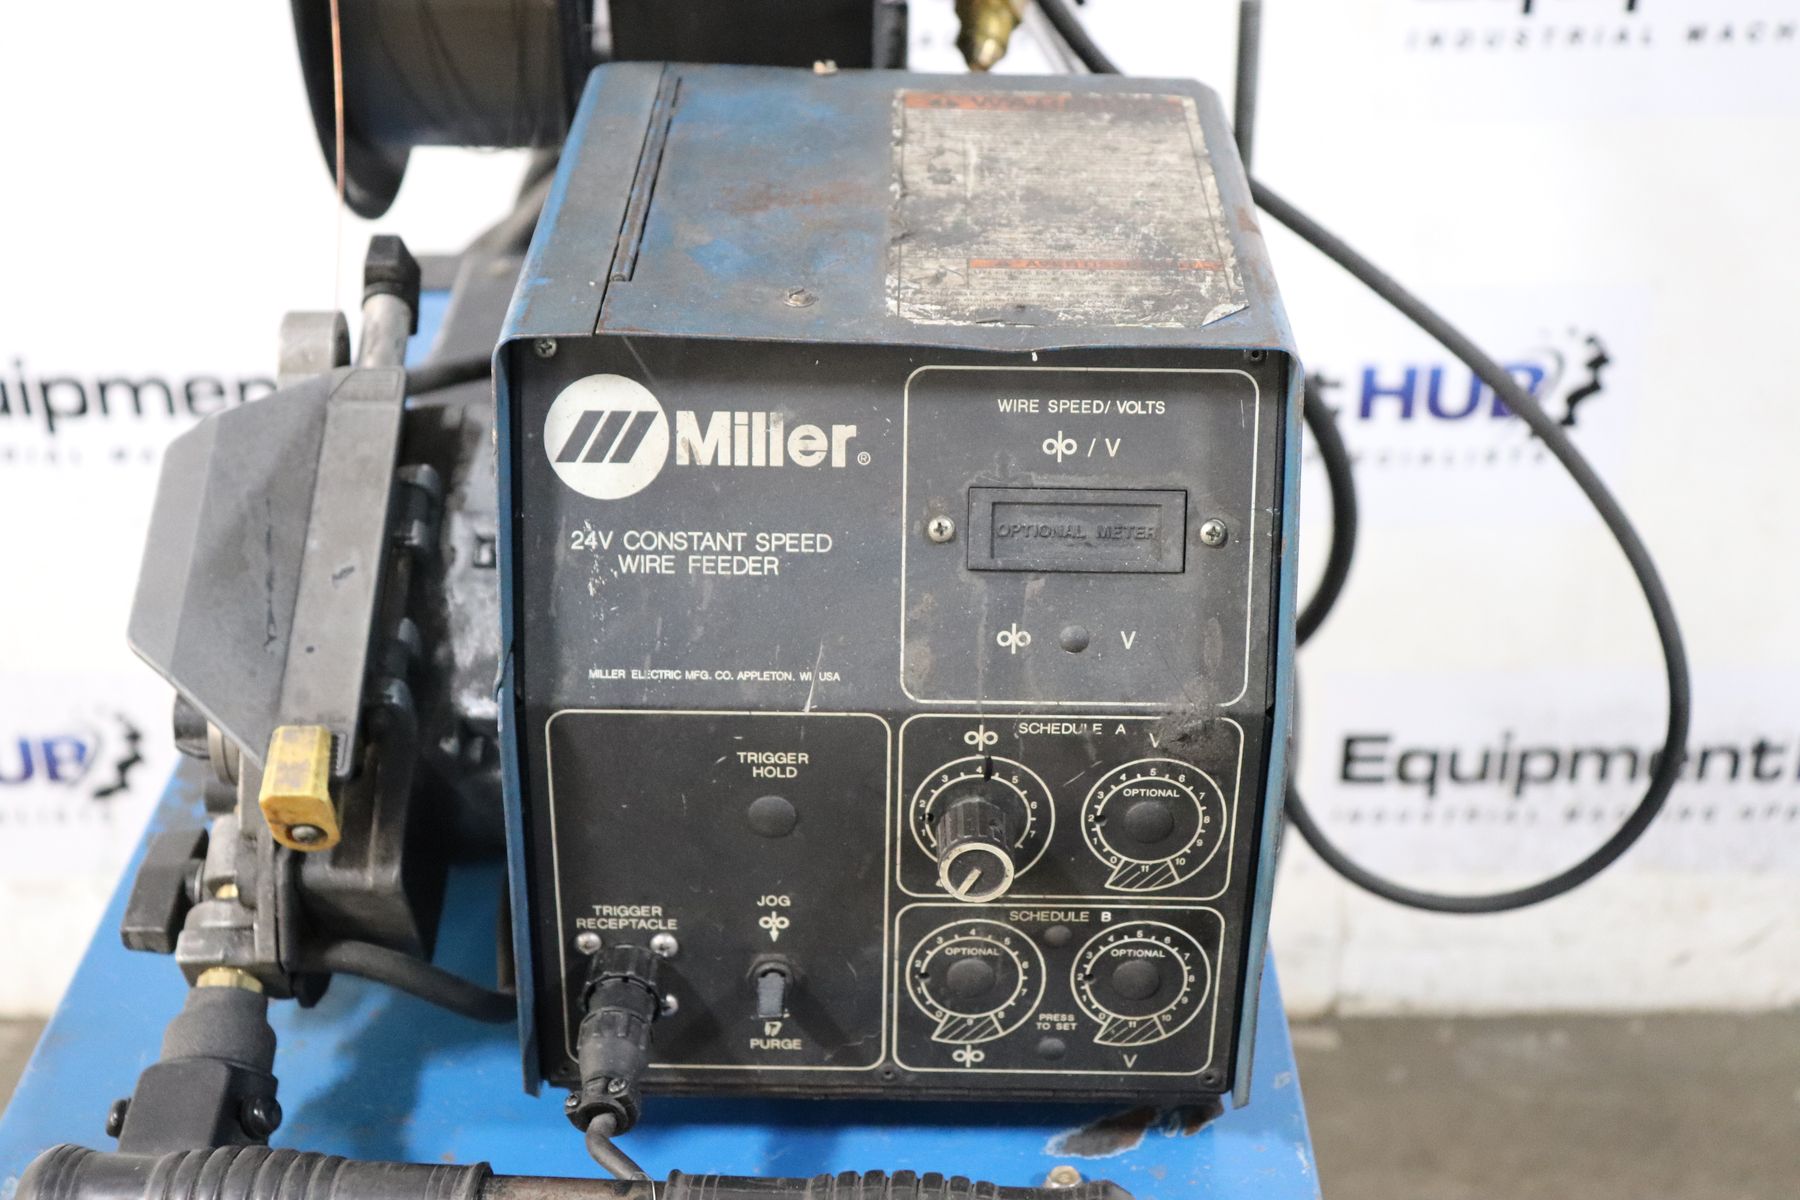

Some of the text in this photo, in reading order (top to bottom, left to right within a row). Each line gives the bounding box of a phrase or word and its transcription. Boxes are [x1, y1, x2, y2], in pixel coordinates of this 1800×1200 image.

[998, 400, 1039, 413] WIRE
[1105, 438, 1121, 457] V
[996, 524, 1157, 540] OPTIONAL METER
[571, 530, 833, 553] 24V CONSTANT SPEED
[618, 555, 779, 575] WIRE FEEDER
[1120, 631, 1136, 650] V
[588, 669, 626, 680] MILLER
[685, 670, 712, 680] MFG.
[715, 671, 734, 681] CO.
[819, 672, 841, 682] USA
[1018, 722, 1126, 735] SCHEDULE A
[737, 752, 809, 764] TRIGGER
[752, 766, 798, 778] HOLD
[1122, 788, 1180, 798] OPTIONAL
[757, 895, 791, 907] JOG
[592, 905, 662, 917] TRIGGER
[1009, 911, 1112, 922] SCHEDULE B
[576, 918, 678, 930] RECEPTACLE
[944, 947, 1000, 956] OPTIONAL
[1110, 949, 1166, 958] OPTIONAL
[1038, 1013, 1075, 1022] PRESS
[1036, 1022, 1078, 1031] TO SET
[750, 1038, 802, 1050] PURGE
[1122, 1053, 1138, 1069] V
